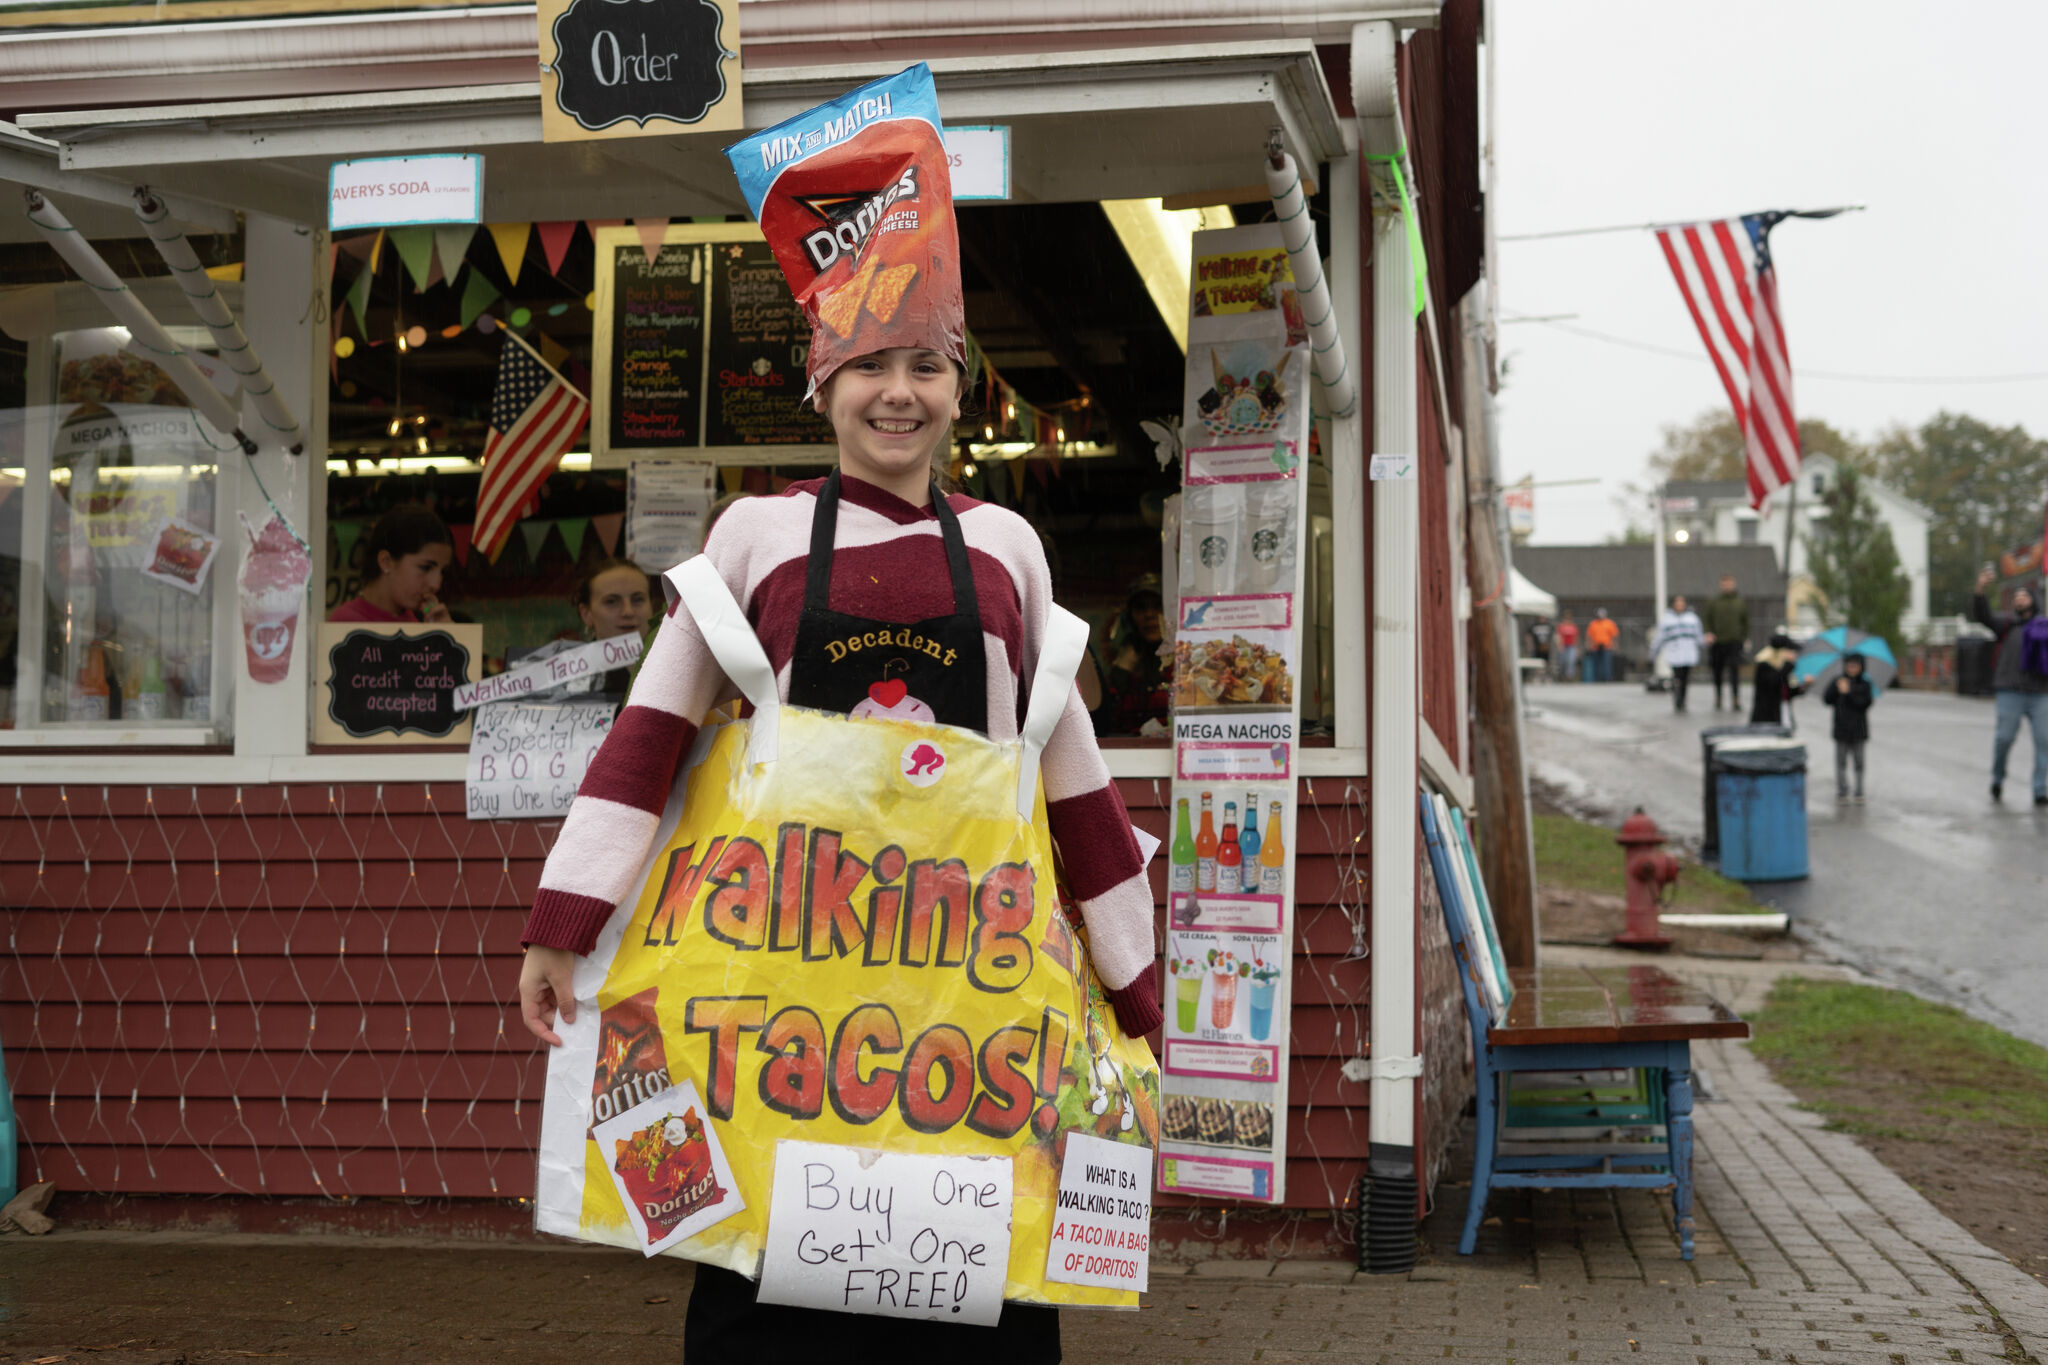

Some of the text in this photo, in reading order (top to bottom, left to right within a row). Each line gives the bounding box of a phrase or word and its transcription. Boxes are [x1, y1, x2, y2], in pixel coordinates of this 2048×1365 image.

[591, 30, 678, 86] Order
[760, 92, 893, 172] MIX AND MATCH
[332, 184, 385, 200] AVERYS
[388, 181, 430, 196] SODA
[806, 168, 917, 270] Doritos
[878, 220, 919, 237] CHEESE
[728, 265, 787, 282] Cinnamo
[1199, 256, 1258, 281] Walking
[623, 359, 672, 376] Orange
[71, 421, 188, 445] MEGA NACHOS
[361, 646, 444, 672] All major
[824, 629, 958, 666] Decadent
[352, 667, 455, 689] credit cards
[458, 638, 643, 705] Walking Taco Only
[367, 692, 437, 721] accepted
[482, 703, 597, 734] Rainy Day
[493, 719, 577, 762] Special
[1177, 724, 1292, 739] MEGA NACHOS
[469, 786, 500, 817] Buy
[513, 784, 544, 811] One
[644, 822, 1037, 992] Walking
[1179, 932, 1278, 943] ICE CREAM SODA FLOATS
[684, 995, 1068, 1138] Tacos!
[588, 1067, 672, 1127] oritos
[643, 1167, 715, 1218] Doritos
[1086, 1164, 1137, 1190] WHAT IS A
[804, 1162, 999, 1242] Buy One
[1058, 1189, 1114, 1215] WALKING
[1117, 1199, 1142, 1220] TACO
[798, 1228, 986, 1266] Get One
[1053, 1222, 1147, 1252] A TACO IN A BAG
[1064, 1253, 1138, 1279] OF DORITOS!
[844, 1268, 968, 1314] FREE!
